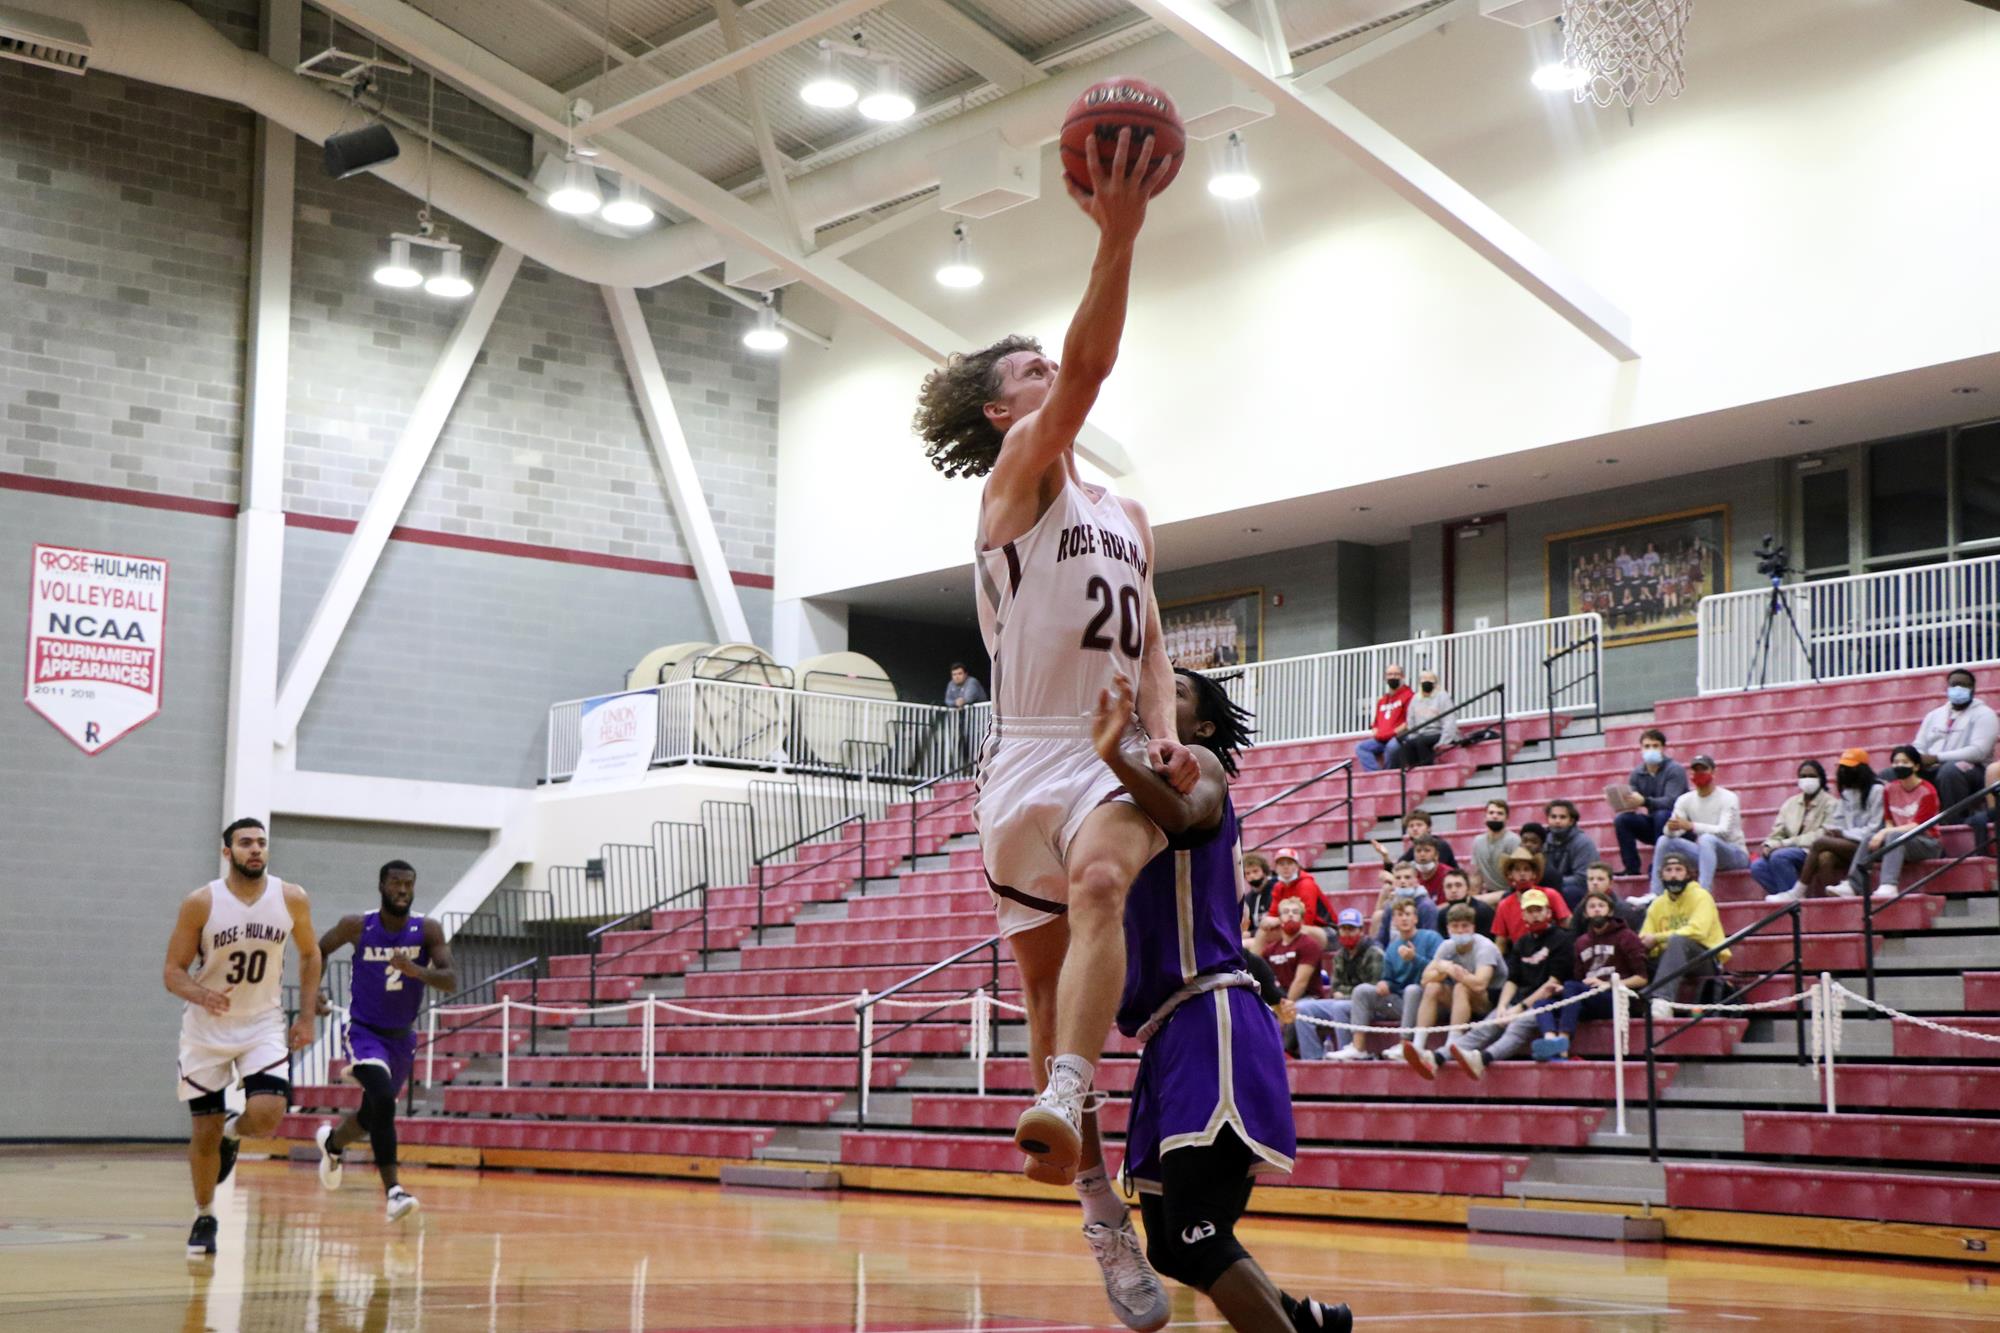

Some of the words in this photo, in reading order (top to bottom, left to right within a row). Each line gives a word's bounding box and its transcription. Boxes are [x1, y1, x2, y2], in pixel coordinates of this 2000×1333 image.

[40, 551, 162, 581] ROSE-HULMAN
[40, 579, 158, 612] VOLLEYBALL
[49, 613, 146, 642] NCAA
[1080, 574, 1143, 660] 20
[40, 640, 153, 666] TOURNAMENT
[41, 658, 151, 688] APPEARANCES
[34, 685, 65, 695] 2011
[600, 721, 637, 741] HEALTH
[226, 950, 268, 984] 30
[363, 945, 421, 961] ALBON
[385, 965, 404, 991] 2
